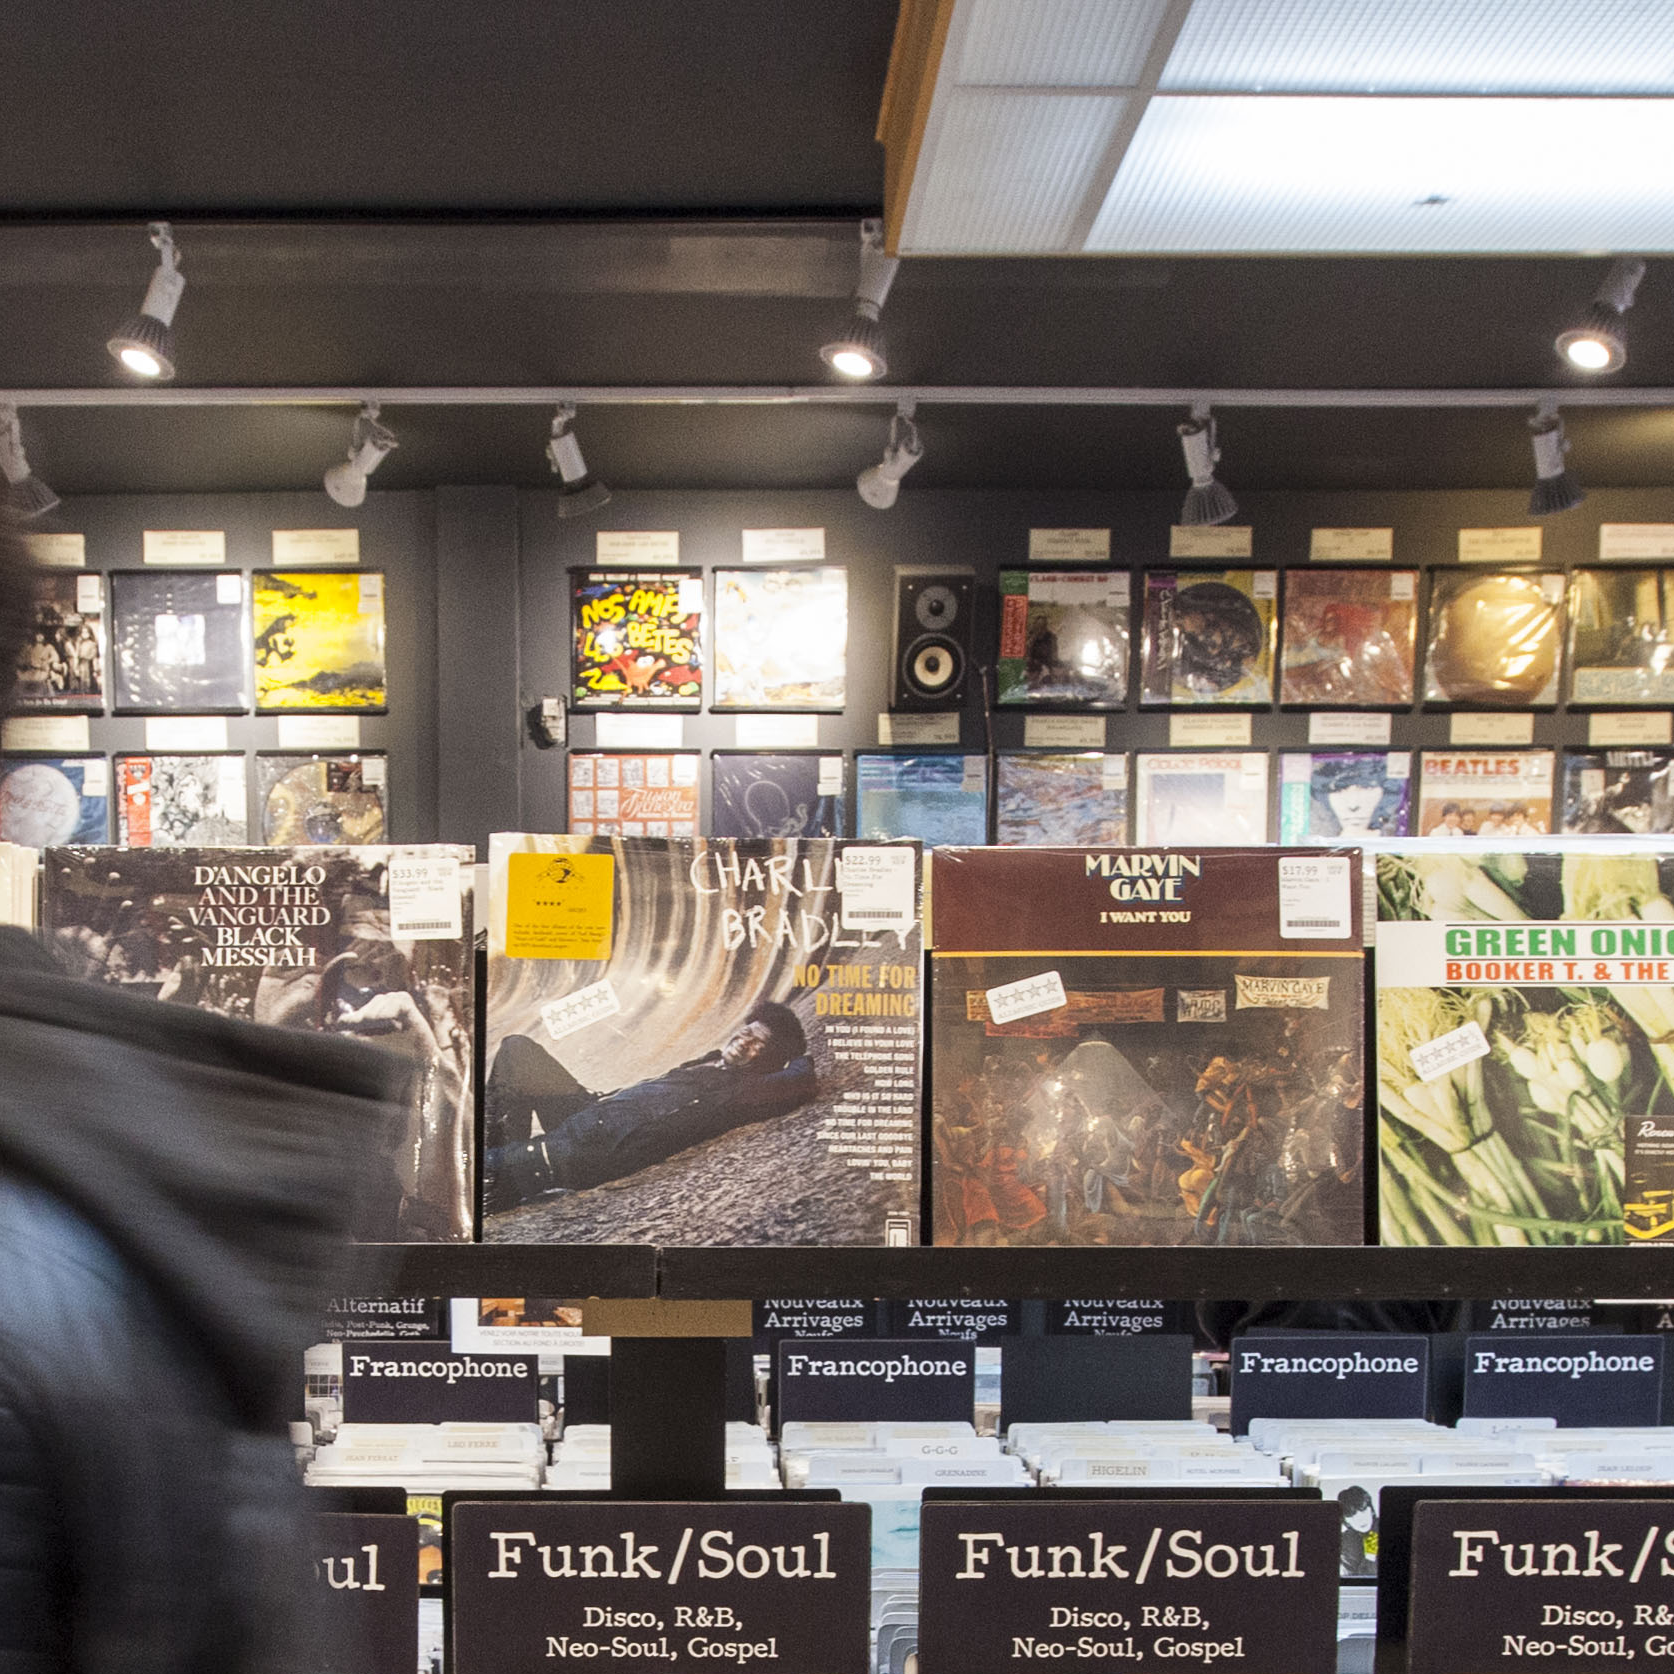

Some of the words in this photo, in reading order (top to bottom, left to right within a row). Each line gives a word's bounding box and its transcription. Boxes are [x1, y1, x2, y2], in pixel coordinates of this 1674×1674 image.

[581, 593, 626, 628] NOS
[1424, 758, 1520, 777] BEATLES
[194, 865, 326, 886] D'ANGELO
[1085, 855, 1200, 877] MARVIN
[200, 887, 258, 906] AND
[265, 887, 319, 905] THE
[1110, 878, 1182, 901] GAYE
[188, 907, 330, 927] VANGUARD
[1100, 912, 1107, 923] I
[1110, 912, 1156, 923] WANT
[1161, 912, 1191, 923] YOU
[217, 927, 301, 947] BLACK
[1445, 929, 1576, 956] GREEN
[201, 947, 316, 967] MESSIAH
[794, 965, 820, 987] NO
[827, 965, 872, 987] TIME
[880, 965, 916, 988] FOR
[1446, 962, 1553, 981] BOOKER
[1563, 962, 1584, 980] T.
[1595, 962, 1614, 981] &
[1623, 963, 1669, 980] THE
[816, 994, 915, 1016] DREAMING
[349, 1356, 528, 1384] Francophone
[787, 1355, 967, 1383] Francophone
[1239, 1352, 1419, 1380] Francophone
[1473, 1352, 1654, 1380] Francophone
[1090, 1462, 1147, 1477] HIGELIN
[488, 1527, 837, 1584] Funk/Soul
[955, 1527, 1306, 1584] Funk/Soul
[584, 1606, 664, 1632] Disco,
[674, 1606, 743, 1632] R&B,
[1050, 1606, 1130, 1631] Disco,
[1141, 1606, 1210, 1631] R&B,
[1541, 1605, 1622, 1630] Disco,
[546, 1637, 677, 1661] Neo-Soul,
[687, 1637, 779, 1664] Gospel
[1012, 1637, 1143, 1661] Neo-Soul,
[1153, 1637, 1245, 1663] Gospel
[1502, 1635, 1635, 1660] Neo-Soul,
